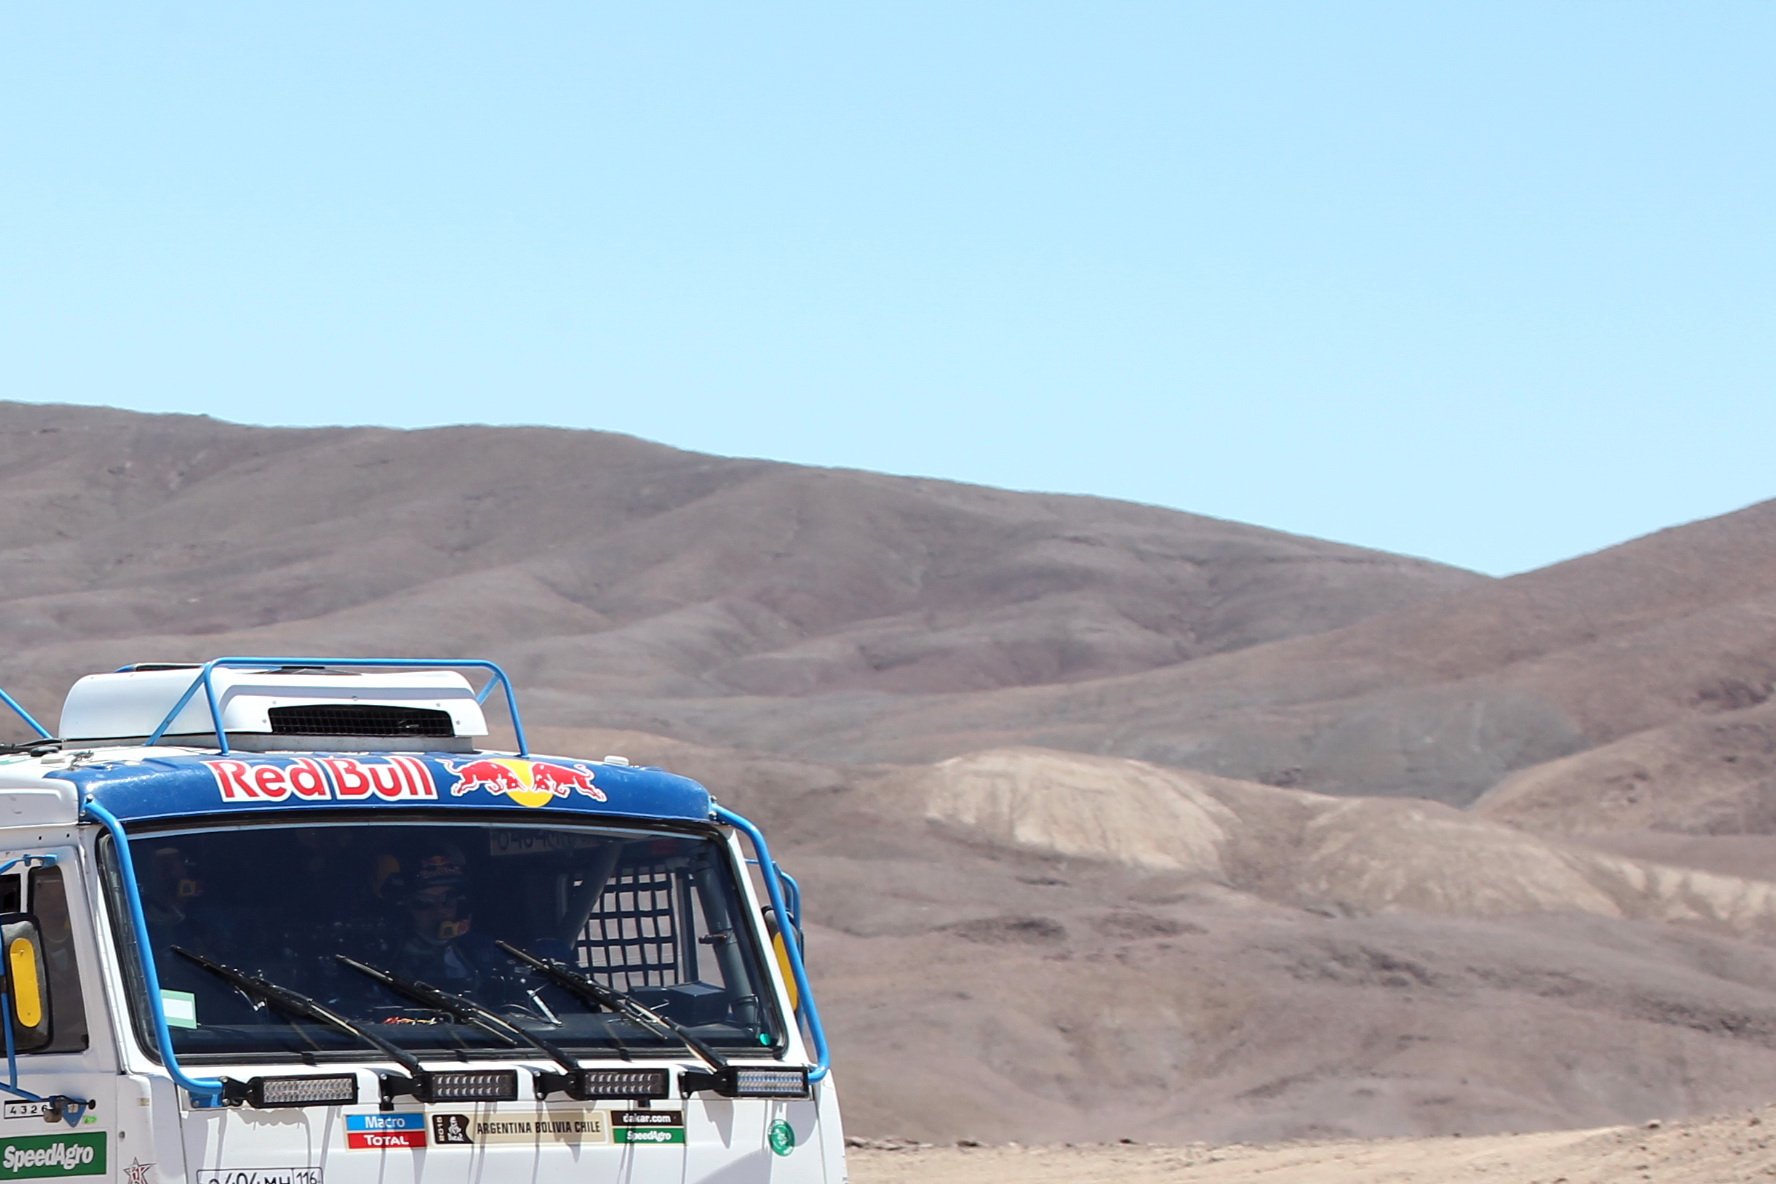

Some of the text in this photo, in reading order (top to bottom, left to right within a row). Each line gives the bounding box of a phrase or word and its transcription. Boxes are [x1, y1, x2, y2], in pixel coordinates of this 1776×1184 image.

[204, 755, 436, 800] Red Bull
[365, 1116, 406, 1129] Macro
[623, 1112, 672, 1124] dakar.com
[477, 1120, 601, 1135] ARGENTINA BOLIVIA CHILE
[364, 1134, 410, 1146] TOTAL
[626, 1128, 672, 1142] SpeedAgro
[2, 1142, 94, 1173] SpeedAgro
